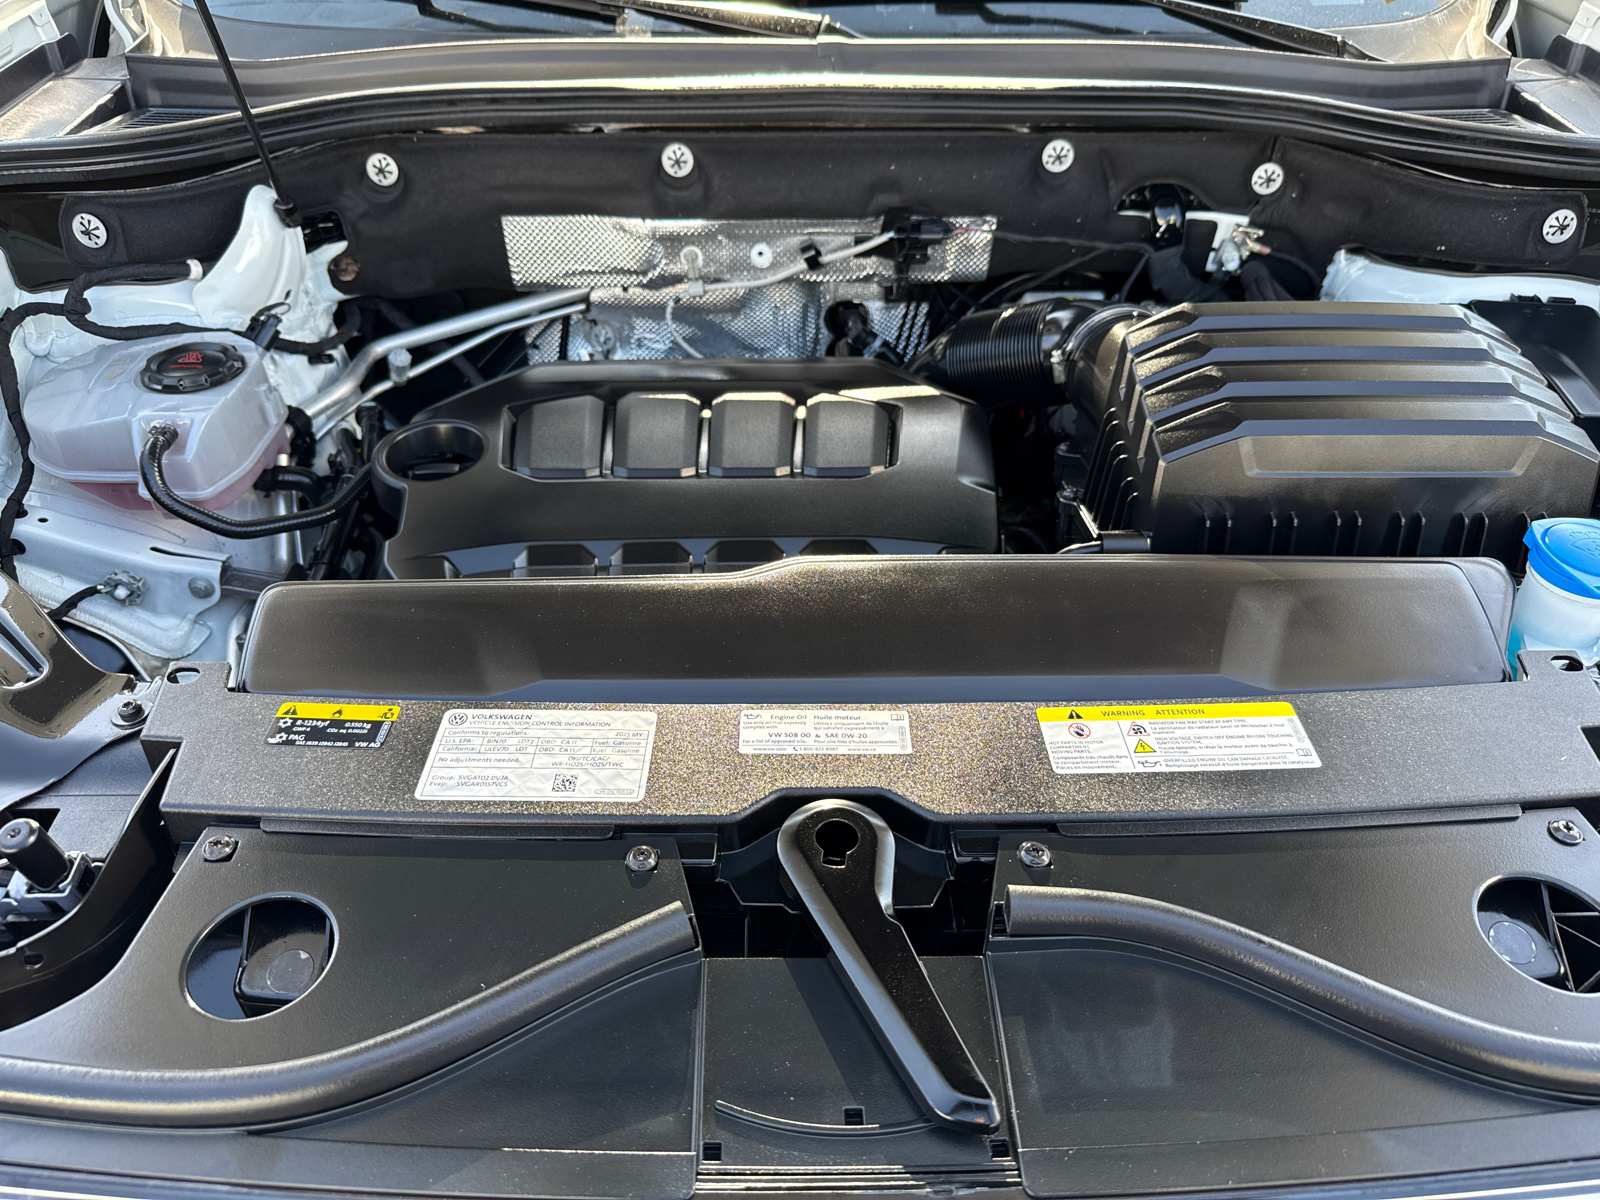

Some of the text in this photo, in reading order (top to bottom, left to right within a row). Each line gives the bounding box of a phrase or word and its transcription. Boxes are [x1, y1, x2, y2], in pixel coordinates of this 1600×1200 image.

[1101, 709, 1145, 717] WARNING
[1156, 708, 1205, 716] ATTENTION
[296, 719, 330, 728] R-1234yf
[363, 723, 371, 731] kg
